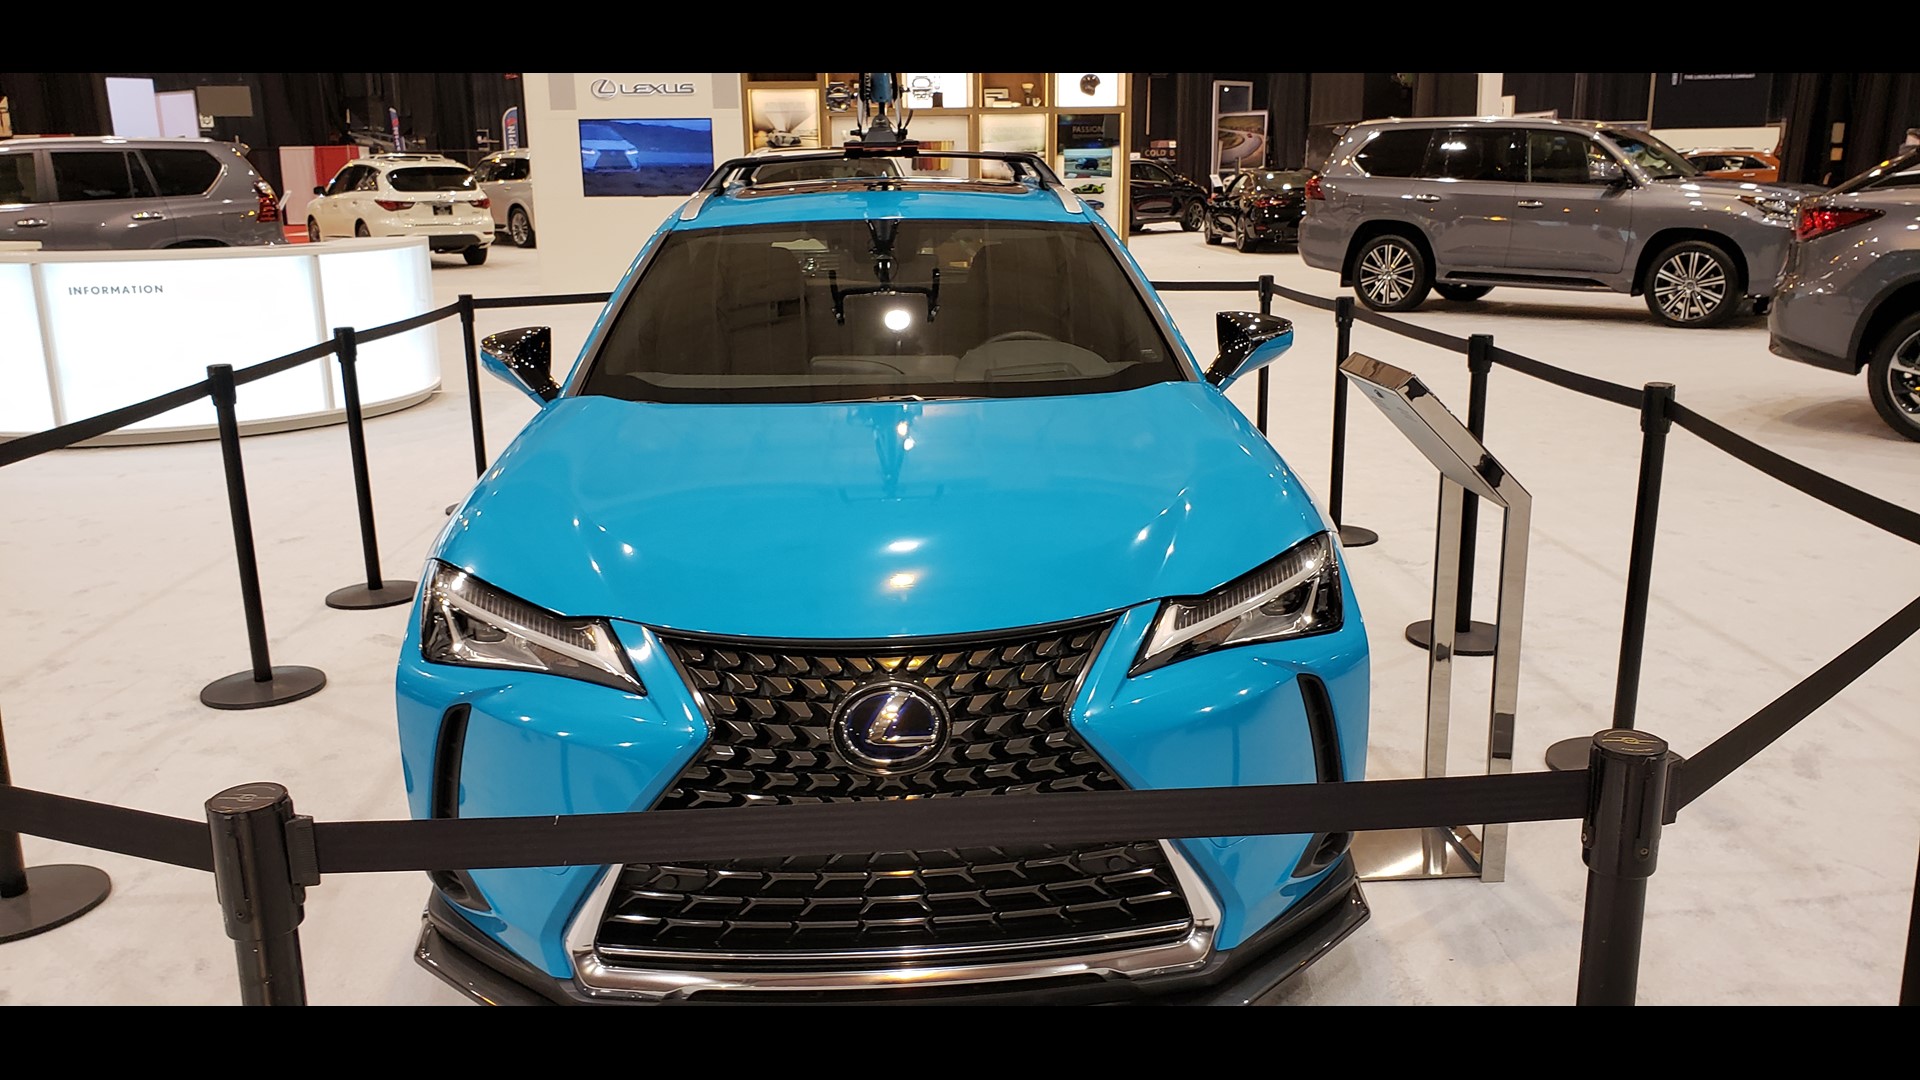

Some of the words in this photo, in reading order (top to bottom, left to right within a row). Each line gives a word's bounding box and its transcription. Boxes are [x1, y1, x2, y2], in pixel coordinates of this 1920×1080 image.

[620, 83, 695, 96] LEXUS
[1072, 125, 1104, 133] PASSION
[1144, 149, 1167, 157] COLD
[68, 285, 164, 295] INFORMATION
